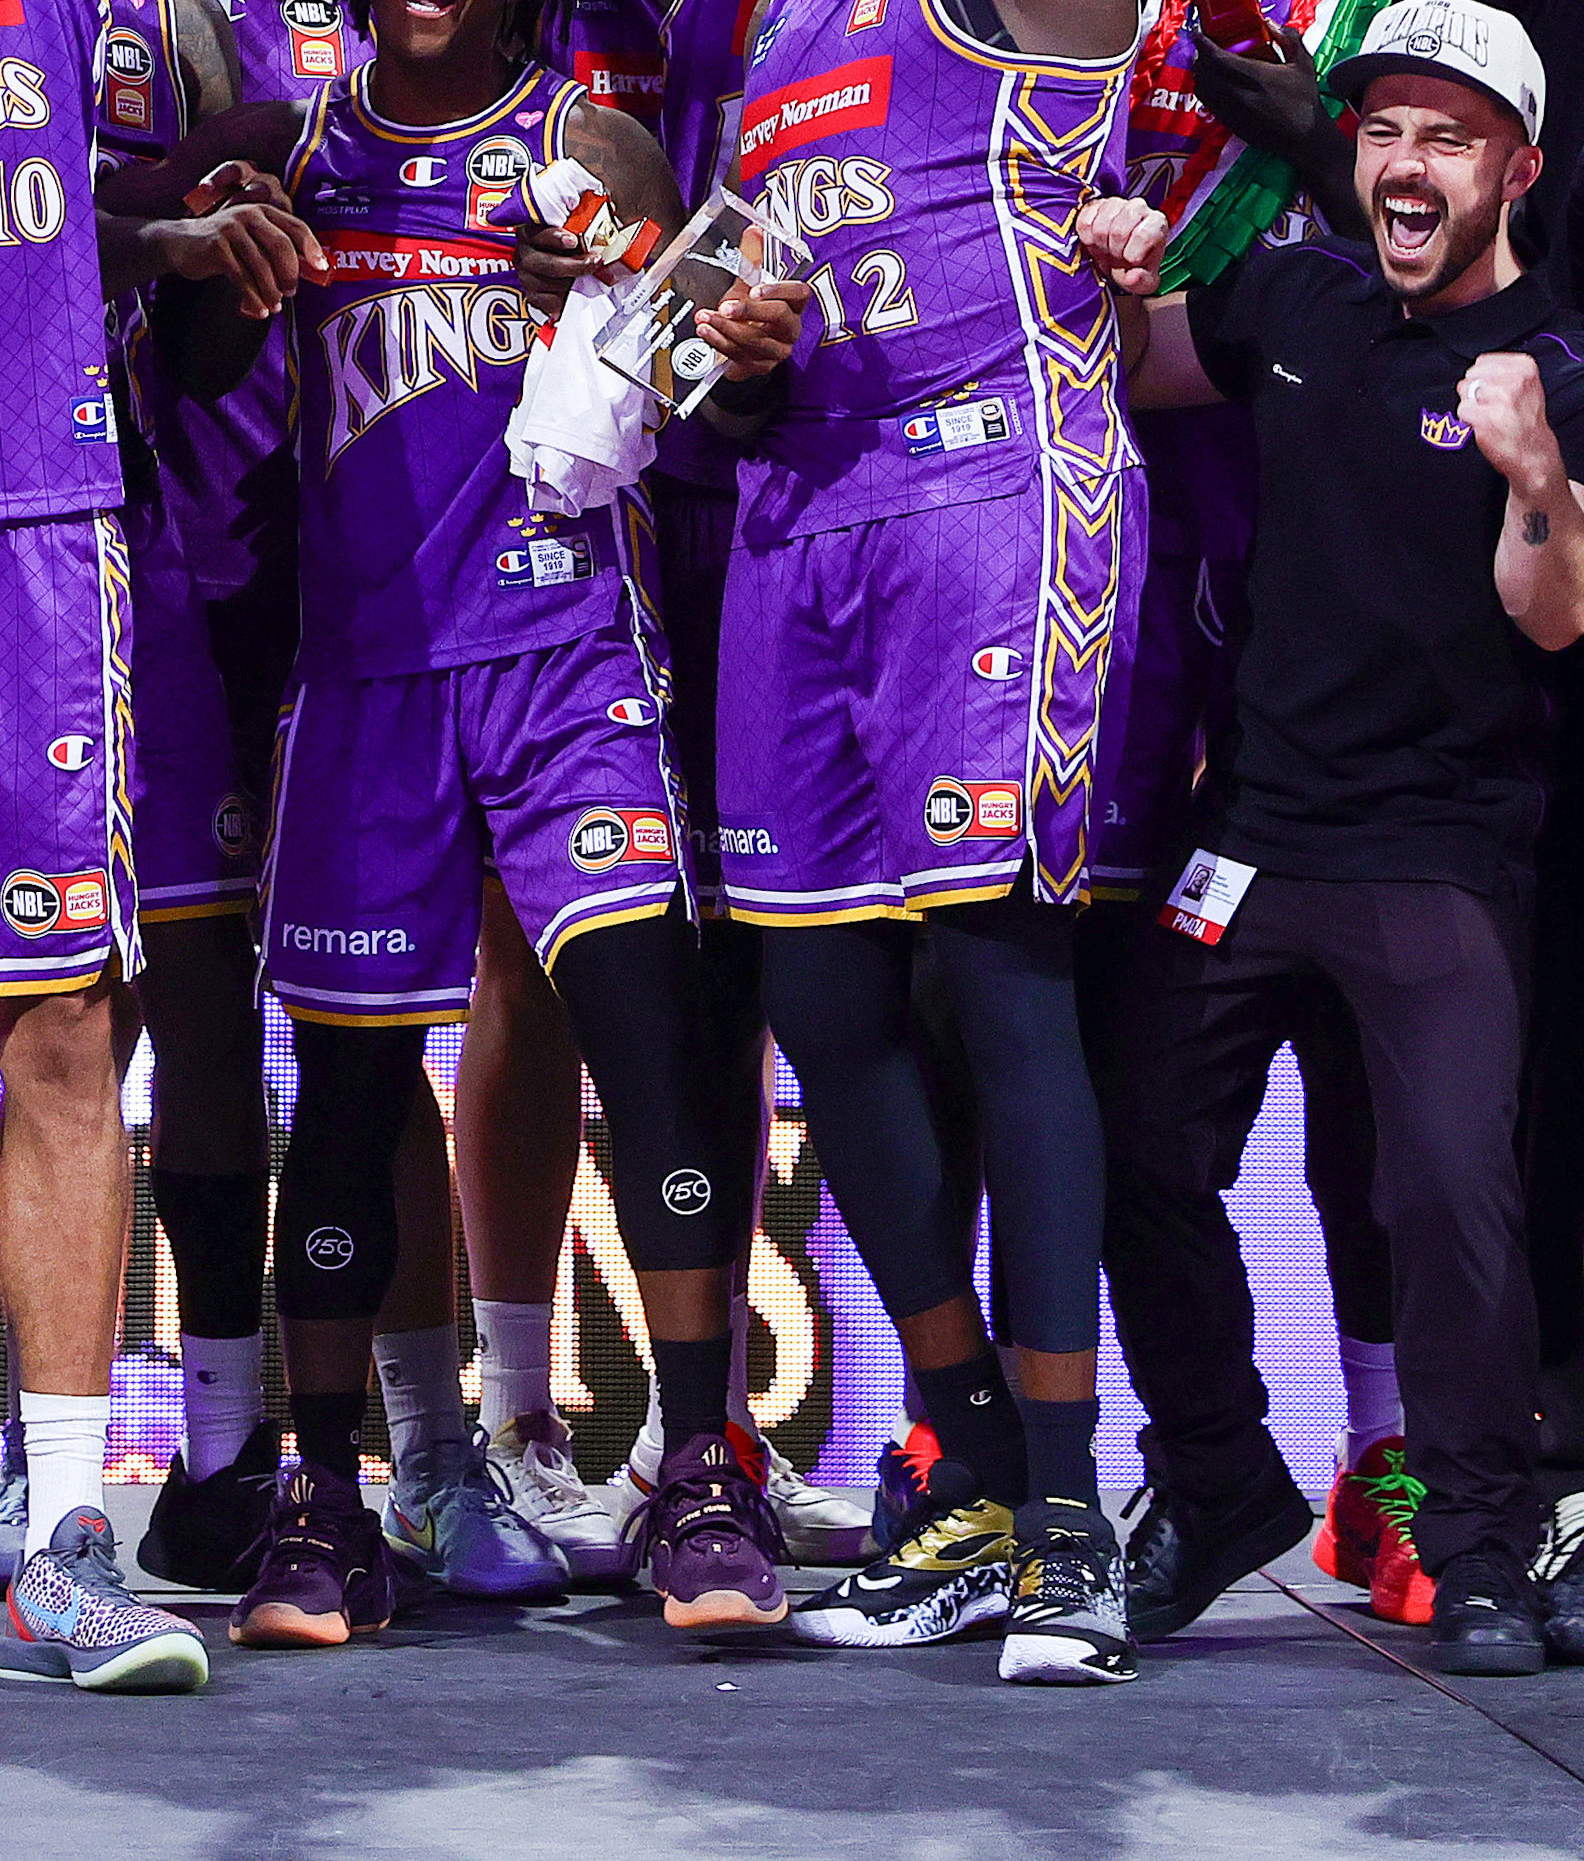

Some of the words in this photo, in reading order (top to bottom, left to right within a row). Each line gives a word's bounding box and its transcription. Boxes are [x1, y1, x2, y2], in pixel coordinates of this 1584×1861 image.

[294, 2, 331, 24] NBL
[112, 45, 145, 72] NBL
[591, 70, 664, 94] Harve
[780, 81, 872, 130] Norman
[481, 154, 517, 177] NBL
[317, 204, 371, 215] HOSTPLUS
[335, 248, 414, 278] arvey
[418, 249, 514, 277] Norm
[807, 249, 919, 347] 12
[681, 347, 708, 373] NBL
[945, 414, 974, 426] SINCE
[537, 550, 566, 563] SINCE
[543, 560, 564, 571] 1919
[931, 797, 961, 824] NBL
[580, 825, 616, 855] NBL
[12, 889, 48, 918] NBL
[68, 892, 100, 903] HUNGRY
[282, 920, 416, 957] remara.
